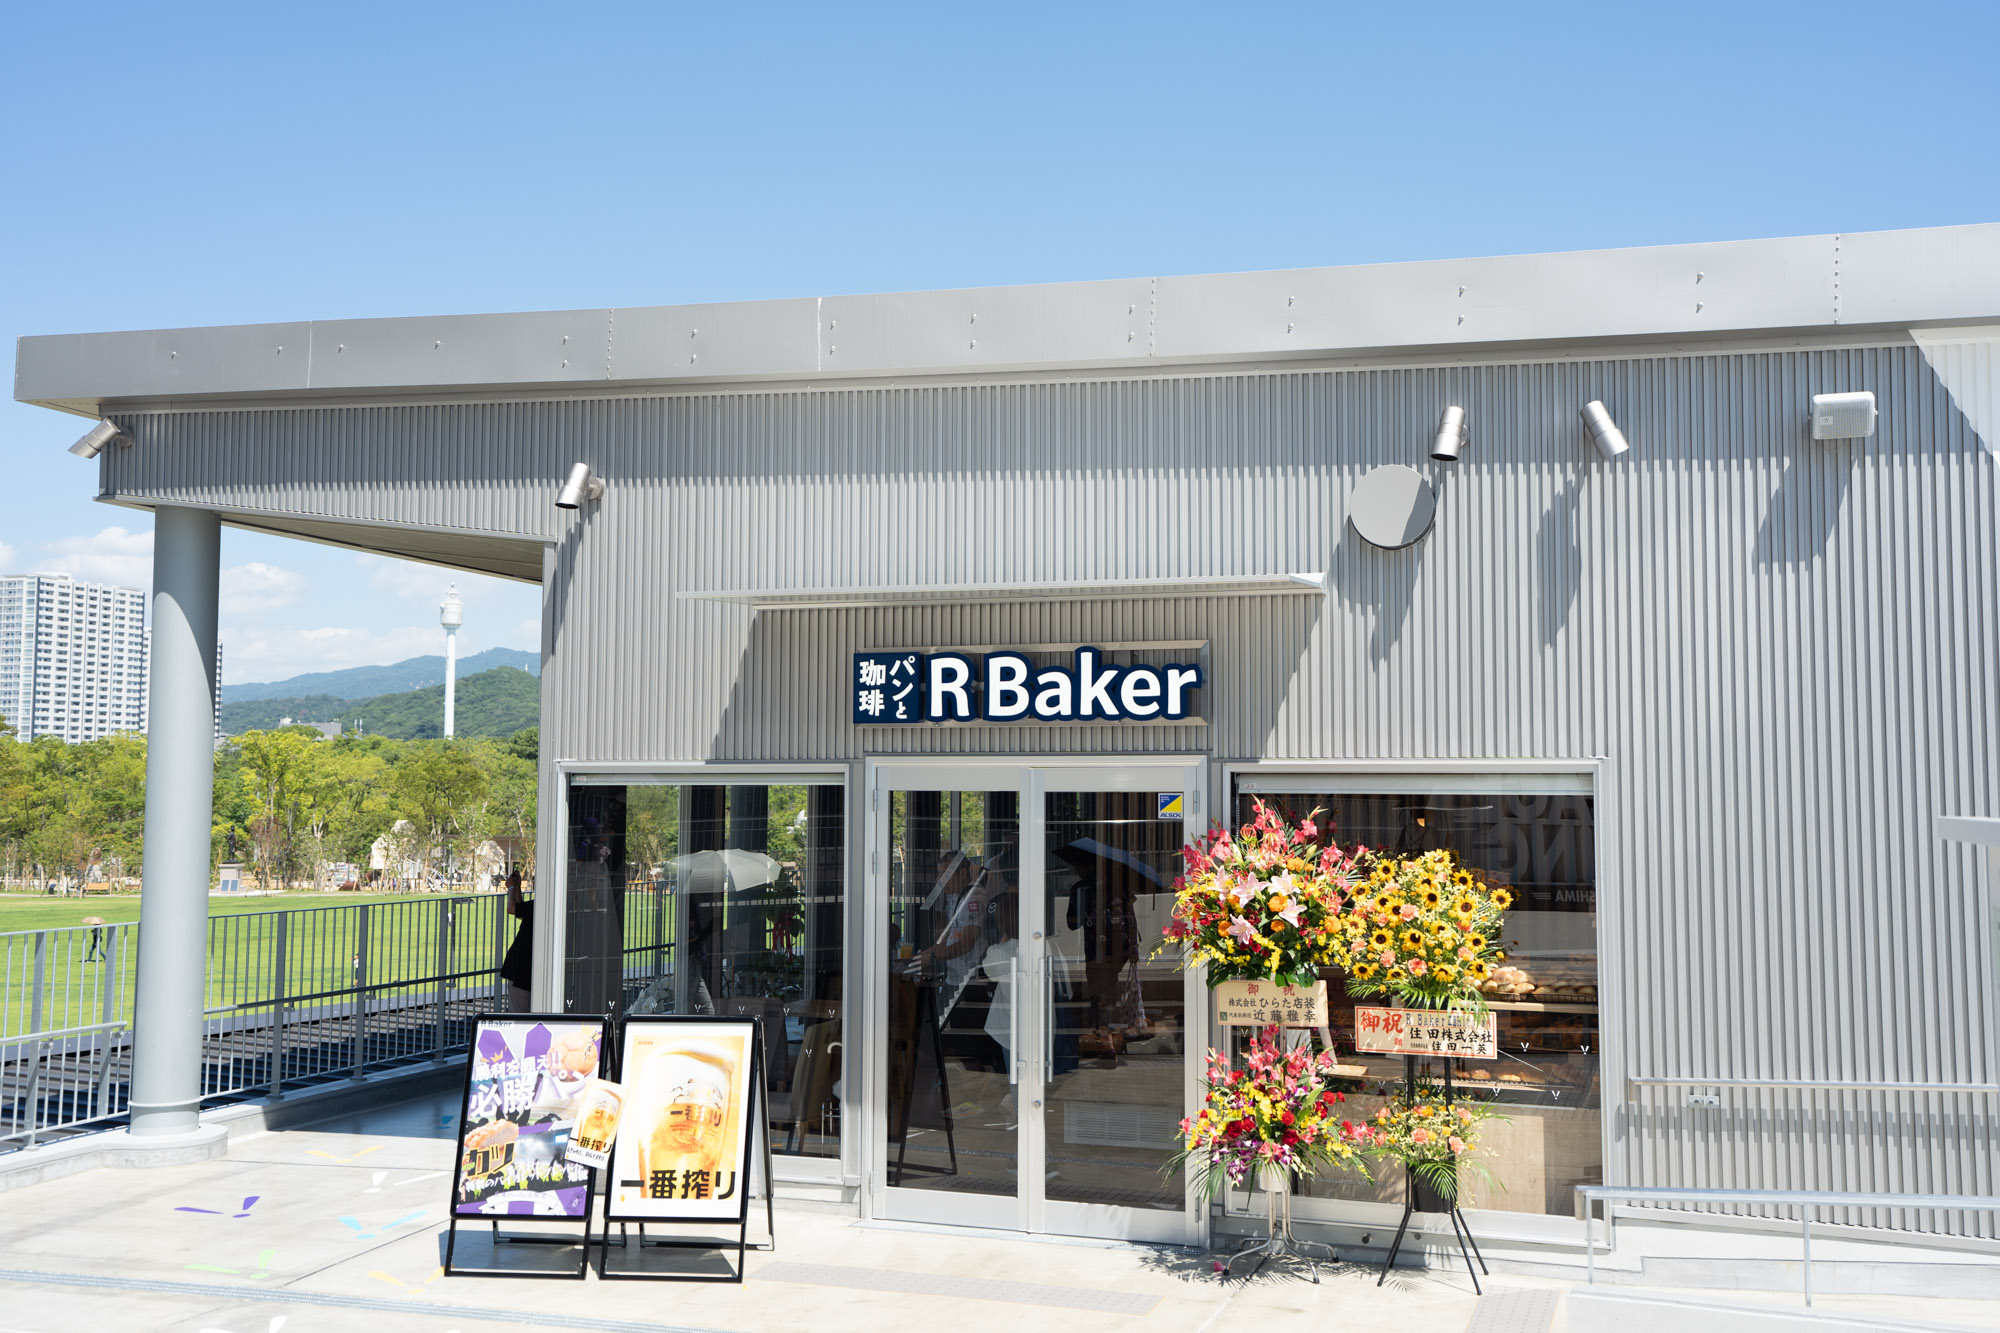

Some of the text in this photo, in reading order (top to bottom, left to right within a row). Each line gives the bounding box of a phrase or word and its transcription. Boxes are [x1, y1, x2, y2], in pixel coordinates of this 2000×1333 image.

[858, 659, 887, 717] 珈琲
[889, 654, 917, 720] パンと
[930, 651, 1197, 718] R Baker
[1360, 1010, 1404, 1035] 御祝
[1409, 1026, 1494, 1043] 住田株式会社
[569, 1136, 613, 1154] 一番搾り
[620, 1169, 736, 1200] 一番搾り
